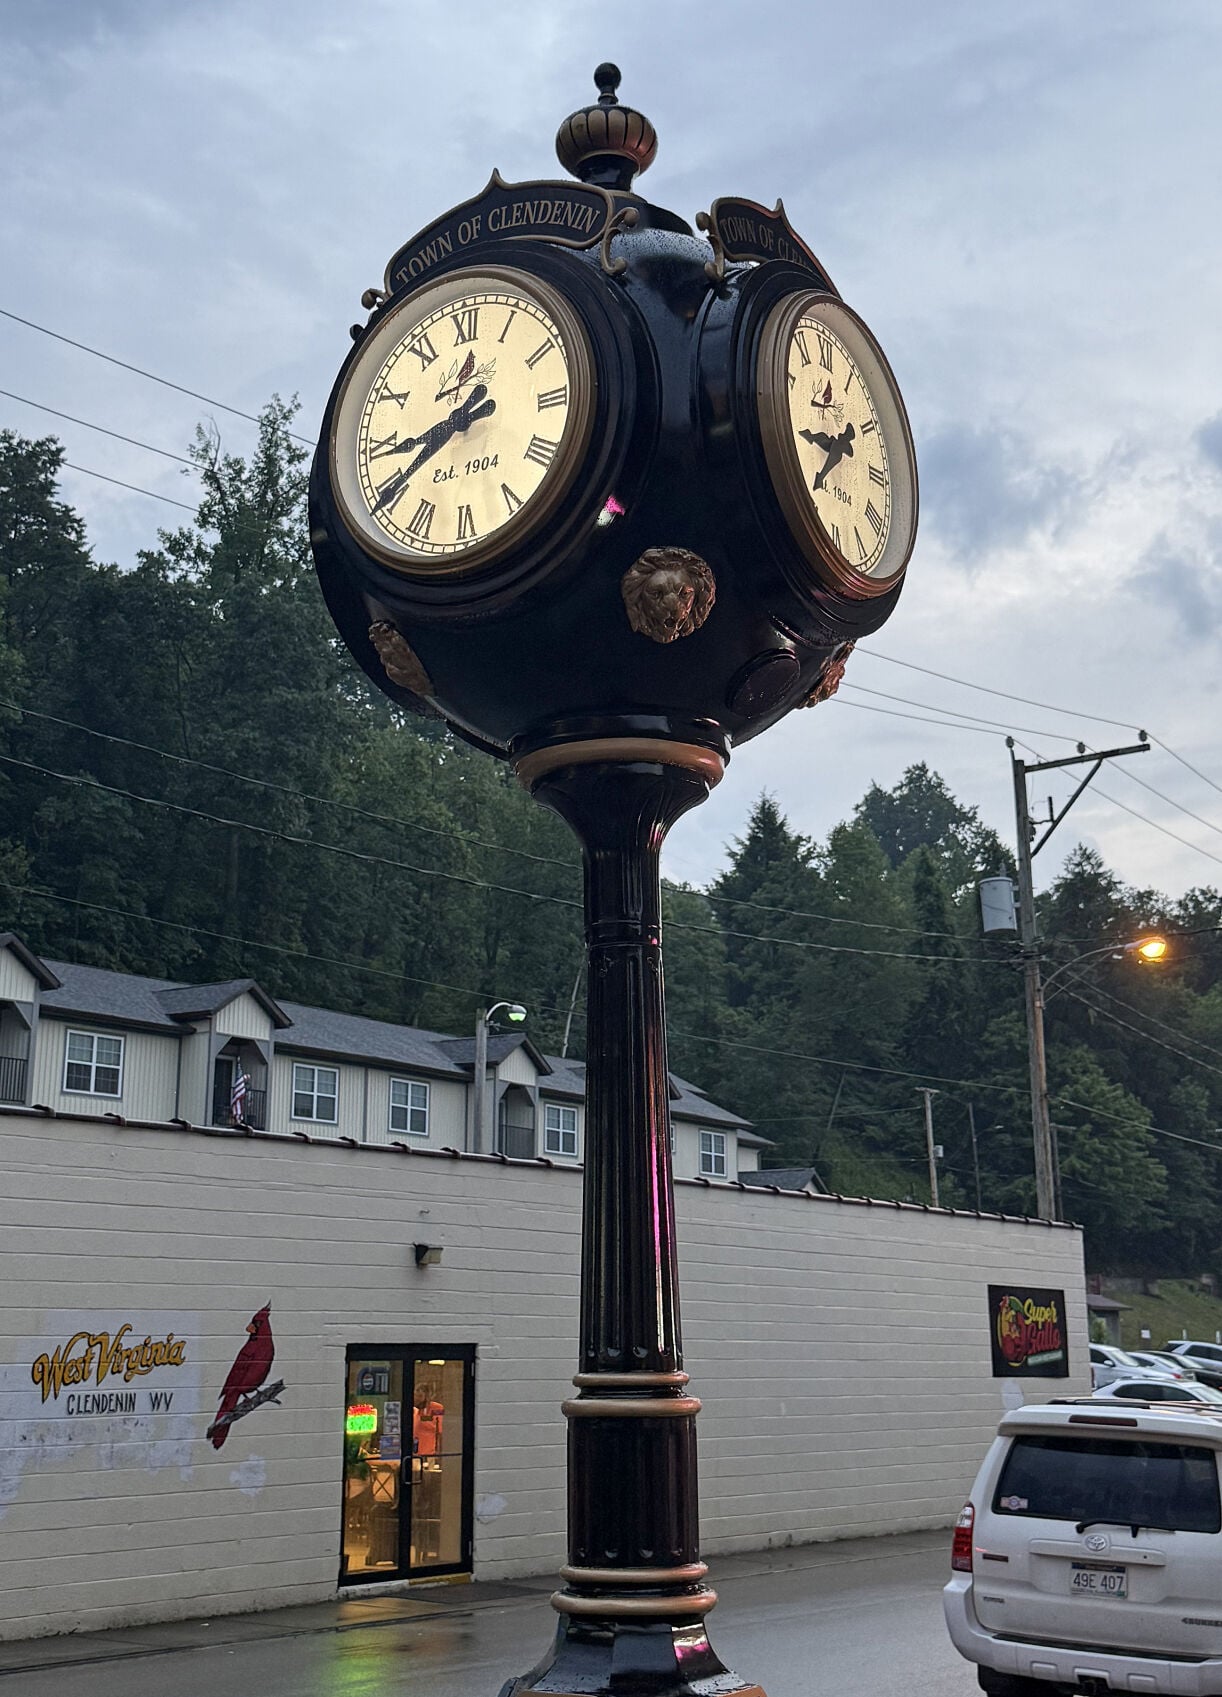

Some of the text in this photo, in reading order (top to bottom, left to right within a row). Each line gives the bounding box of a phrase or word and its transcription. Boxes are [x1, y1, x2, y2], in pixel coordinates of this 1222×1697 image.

[395, 199, 601, 286] TOWN OF CLENDENIN
[720, 216, 757, 244] TOWN
[759, 224, 774, 251] OF
[450, 307, 480, 347] XII
[498, 310, 517, 343] I
[407, 331, 439, 372] XI
[525, 337, 555, 370] II
[794, 331, 811, 367] XI
[816, 333, 833, 374] XII
[377, 382, 410, 409] X
[537, 384, 567, 412] III
[844, 370, 854, 395] I
[860, 418, 876, 436] II
[432, 454, 499, 484] Est. 1904
[868, 463, 884, 489] III
[500, 483, 524, 516] V
[832, 485, 853, 507] 1904
[405, 498, 436, 540] VII
[456, 504, 478, 541] VI
[853, 526, 868, 560] V
[1024, 1298, 1058, 1330] Super
[31, 1323, 187, 1404] West Virginia
[67, 1392, 173, 1415] CLENDENIN WV
[1073, 1572, 1097, 1588] 49E
[1100, 1575, 1124, 1591] 407
